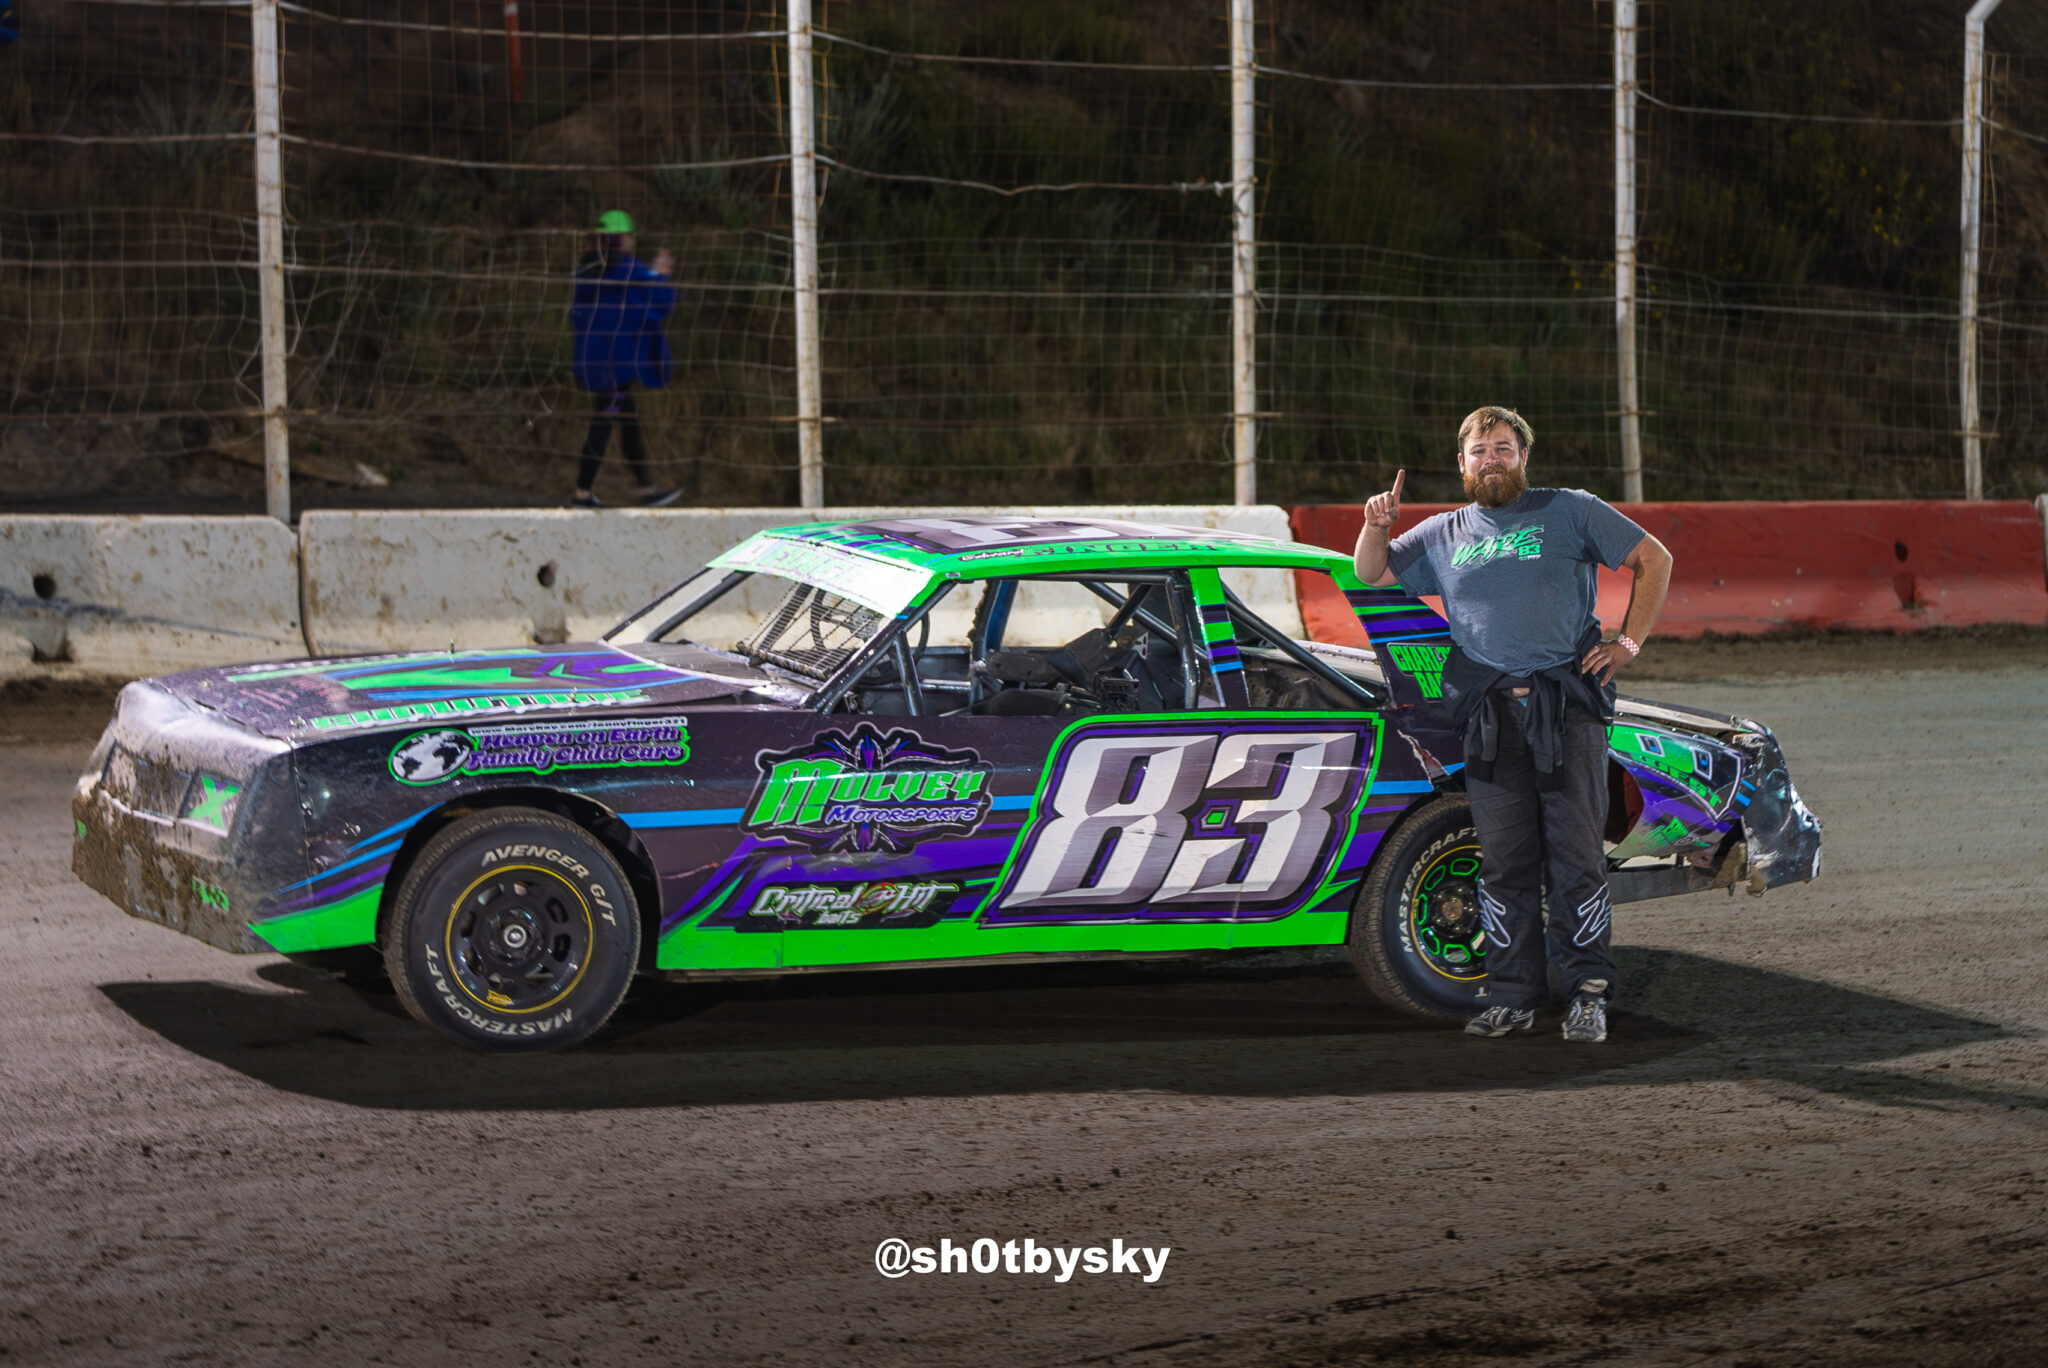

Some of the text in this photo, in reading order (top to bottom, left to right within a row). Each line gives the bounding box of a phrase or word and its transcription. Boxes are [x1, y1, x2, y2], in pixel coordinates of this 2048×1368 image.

[1518, 544, 1541, 557] 83
[480, 725, 680, 750] Heaven on Earth
[467, 742, 682, 770] Family Child Care
[1000, 732, 1357, 908] 83
[481, 844, 590, 880] AVENGER
[424, 943, 574, 1036] MASTERCRAFT
